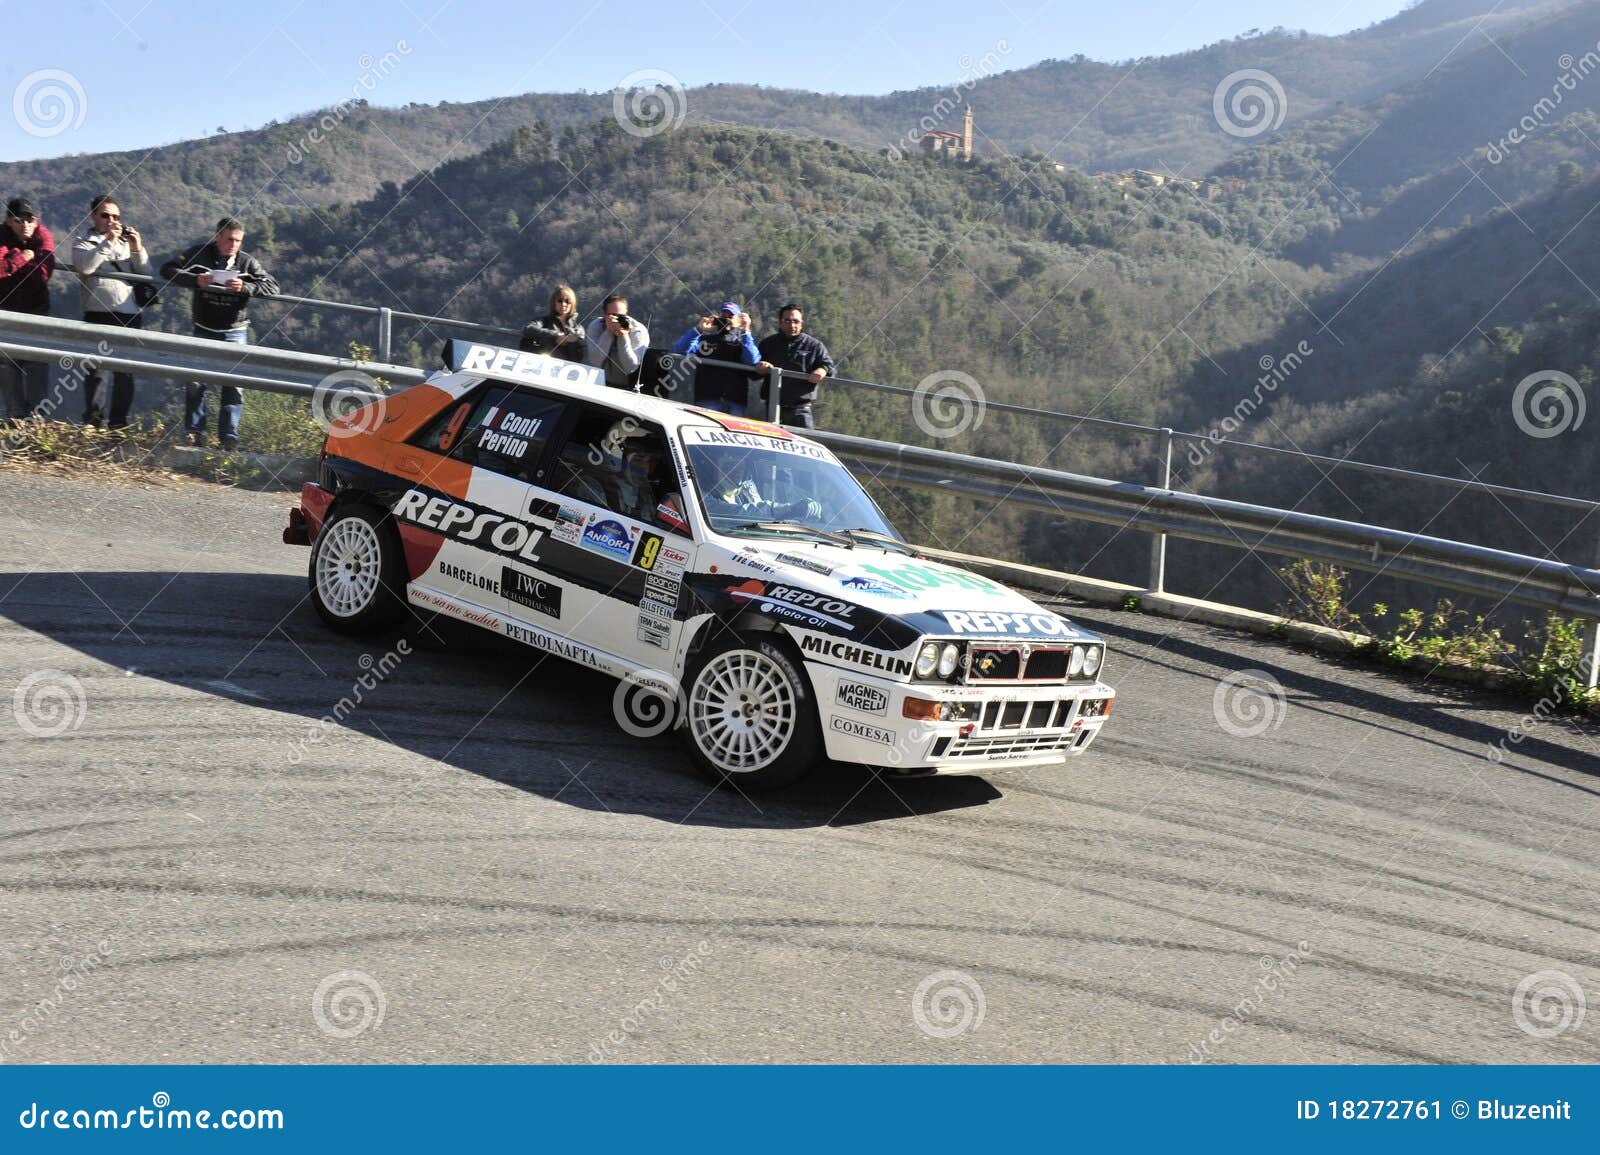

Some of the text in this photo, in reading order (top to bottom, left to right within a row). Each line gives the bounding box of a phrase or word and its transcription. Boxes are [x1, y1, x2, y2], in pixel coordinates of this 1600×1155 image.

[439, 402, 471, 450] 9
[501, 411, 543, 438] Conti
[479, 429, 529, 459] Perino
[695, 430, 763, 448] LANCIA
[392, 489, 543, 560] REPSOL
[586, 530, 631, 551] ANDORA
[640, 536, 661, 569] 9
[662, 549, 685, 562] Tudor
[439, 561, 499, 595] BARCELONE
[516, 573, 547, 599] IWC
[647, 575, 678, 591] sparco
[641, 600, 673, 619] BILSTEIN
[768, 585, 857, 618] REPSOL
[773, 606, 827, 628] Motor Oil
[942, 610, 1077, 637] REPSOL
[505, 622, 597, 667] PETROLNAFTA
[801, 635, 912, 676] MICHELIN
[833, 720, 891, 743] COMESA
